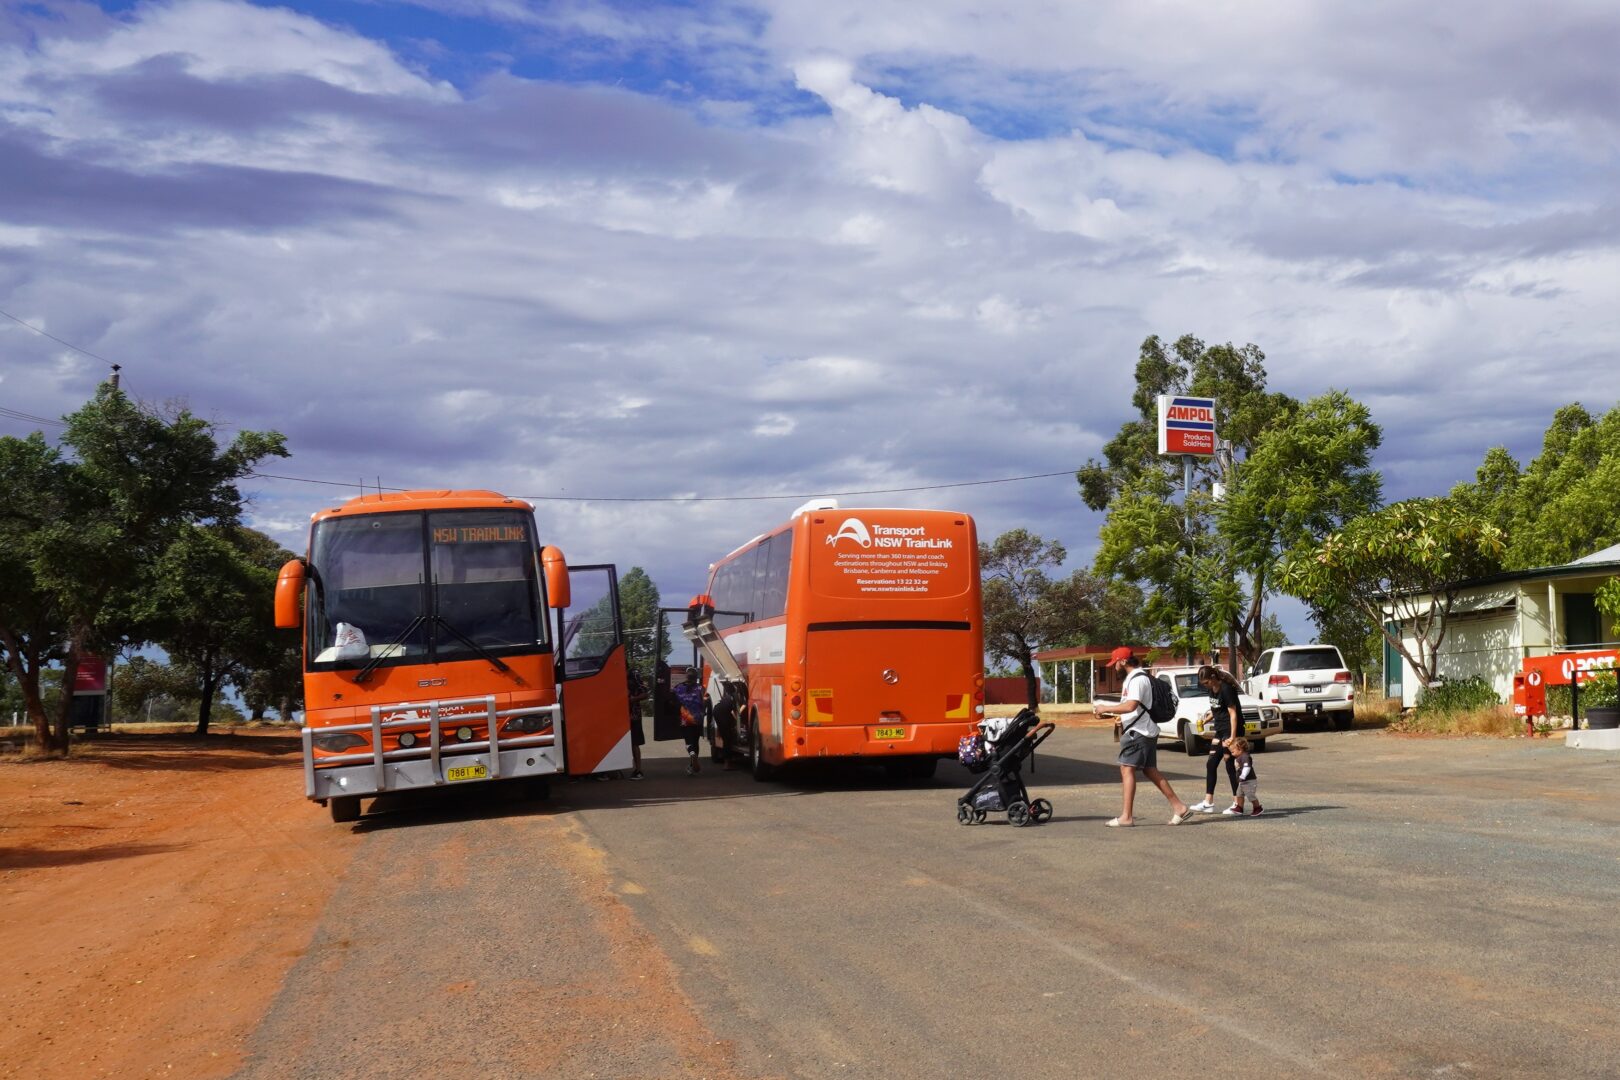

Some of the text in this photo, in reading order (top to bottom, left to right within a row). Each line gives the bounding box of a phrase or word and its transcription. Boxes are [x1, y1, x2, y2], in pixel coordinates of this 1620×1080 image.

[1167, 407, 1213, 421] AMPOL
[1183, 433, 1210, 441] Products
[433, 527, 524, 541] NSW TRAINLINK
[872, 525, 925, 537] Transport
[874, 538, 953, 549] NSW TrainLink
[929, 561, 948, 569] linking
